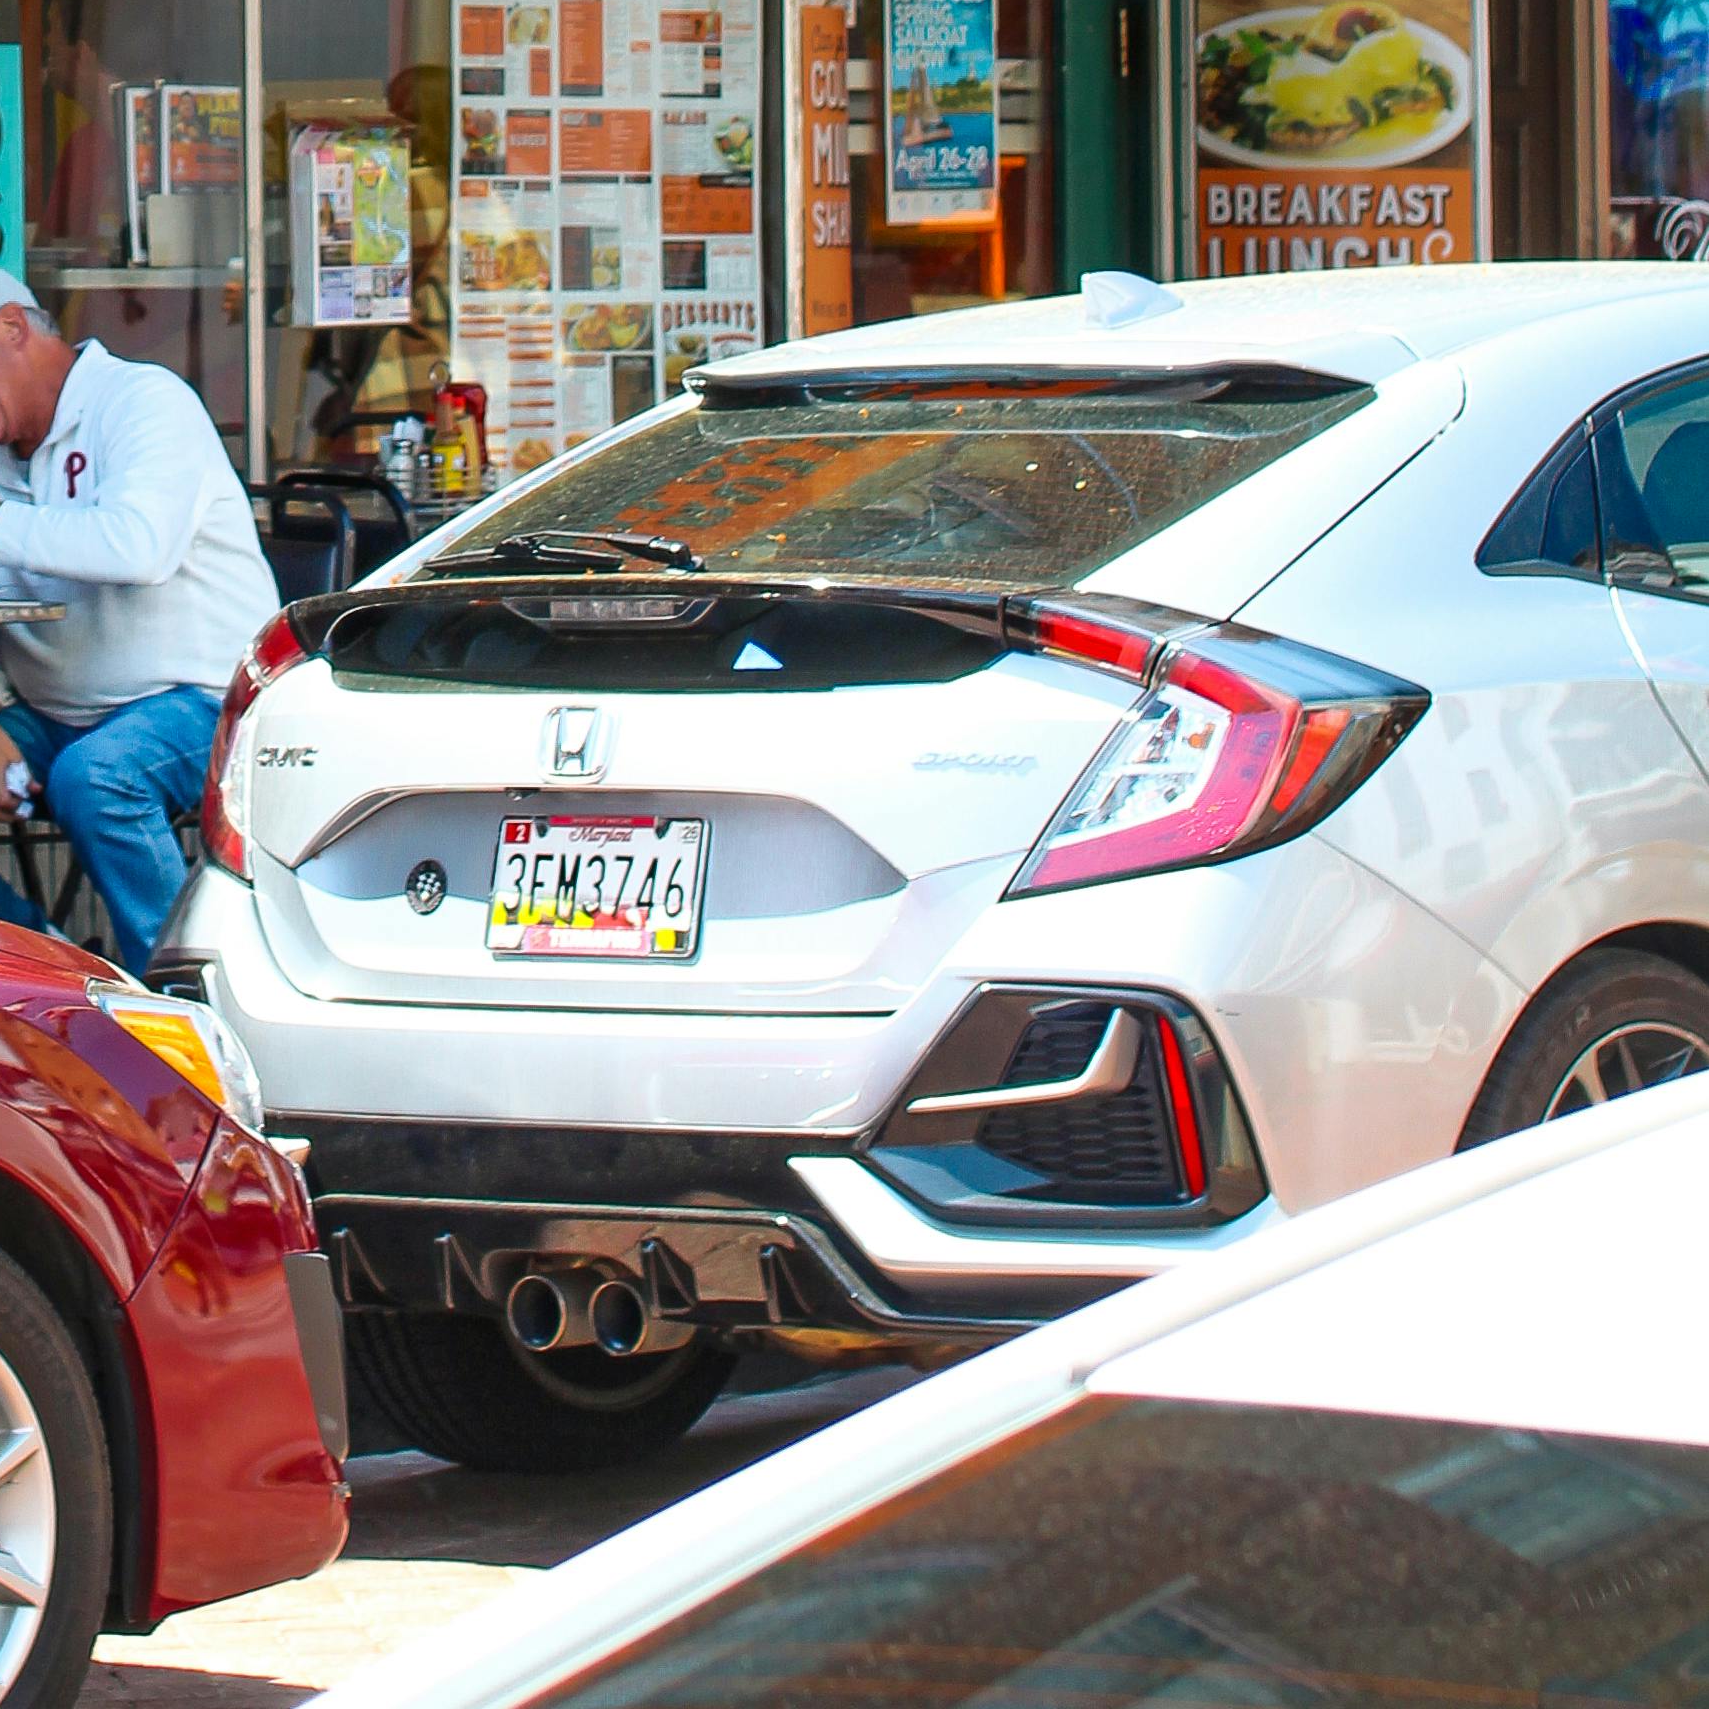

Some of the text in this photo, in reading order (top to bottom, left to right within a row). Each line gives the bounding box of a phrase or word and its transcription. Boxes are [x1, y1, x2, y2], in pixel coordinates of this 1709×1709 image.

[1207, 183, 1451, 227] BREAKFAST
[63, 451, 87, 500] P
[256, 746, 319, 768] CIVIC
[515, 825, 526, 842] 2
[569, 825, 632, 848] Maryland
